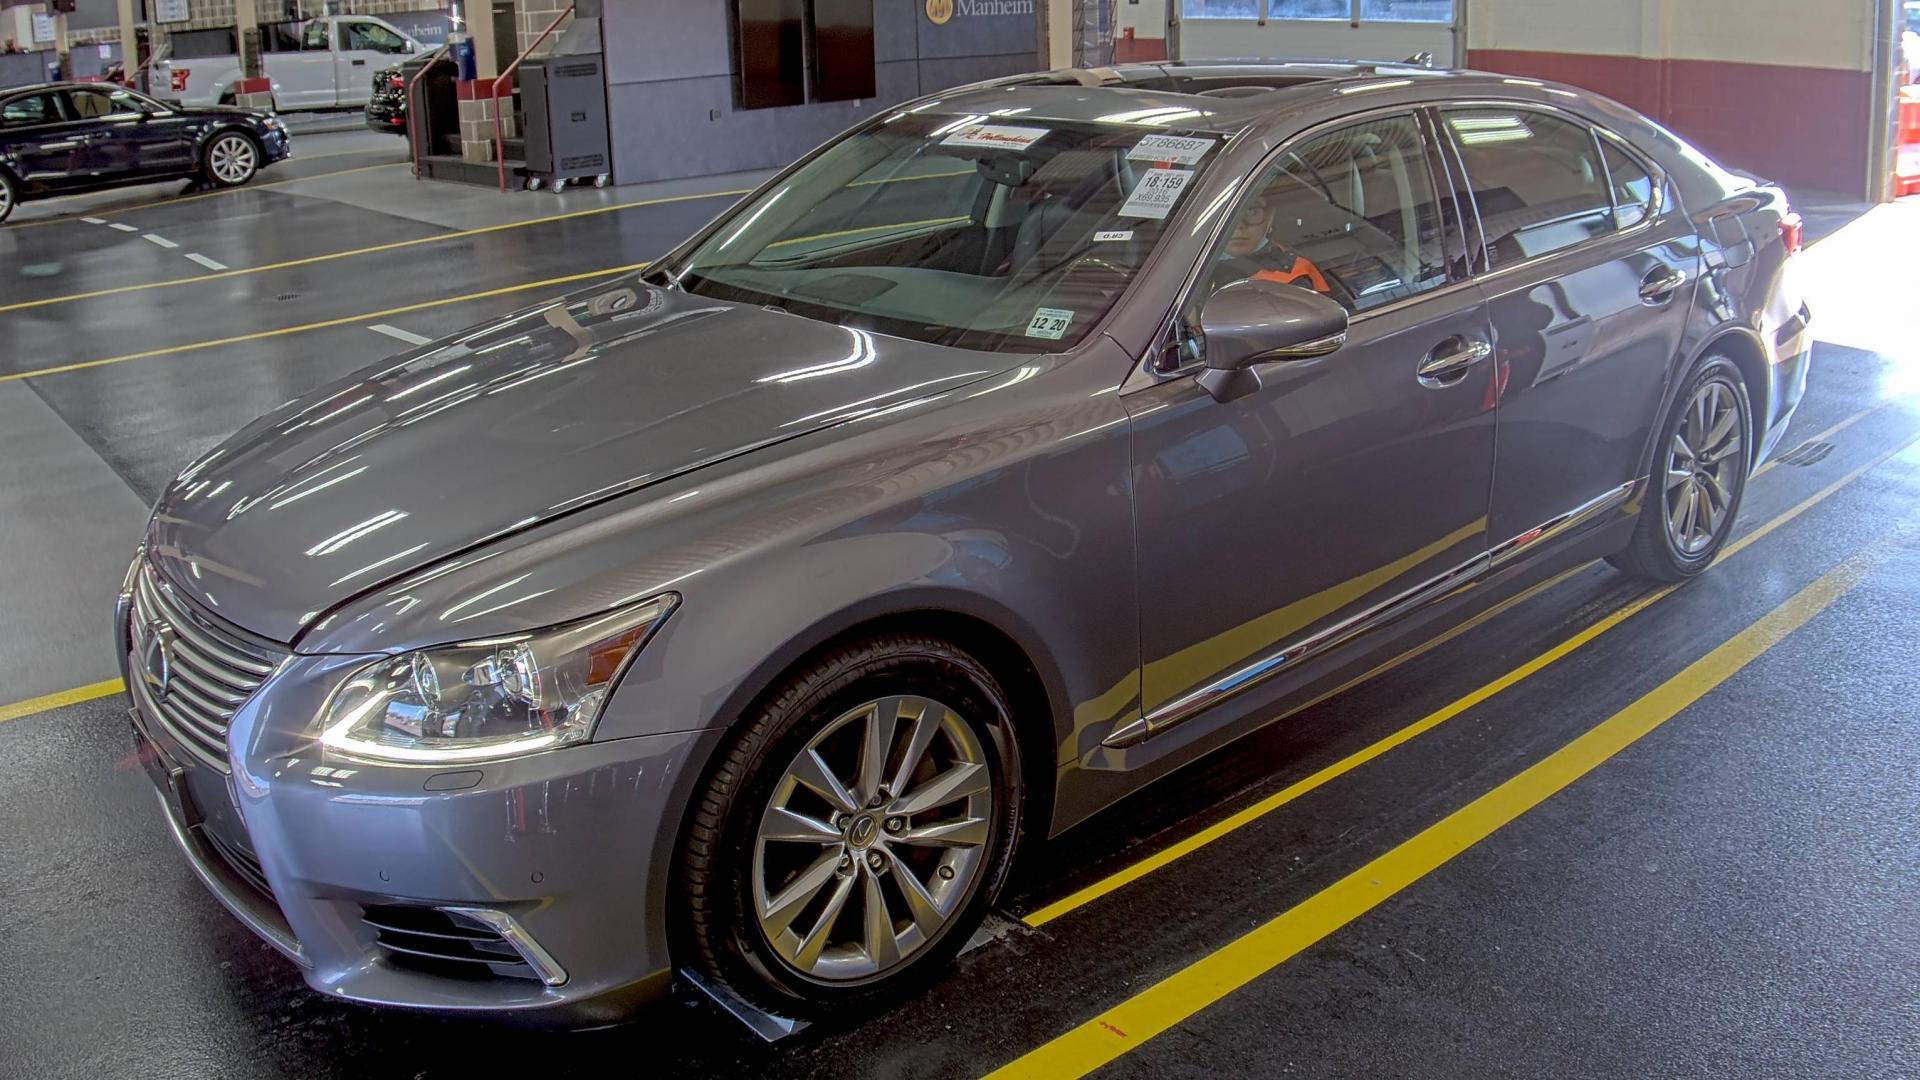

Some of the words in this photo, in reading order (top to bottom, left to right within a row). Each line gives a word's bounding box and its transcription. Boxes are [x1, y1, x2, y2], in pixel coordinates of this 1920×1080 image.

[956, 0, 1033, 16] Manheim
[1144, 176, 1184, 189] 18:159
[1032, 317, 1048, 329] 12
[1050, 319, 1066, 331] 20
